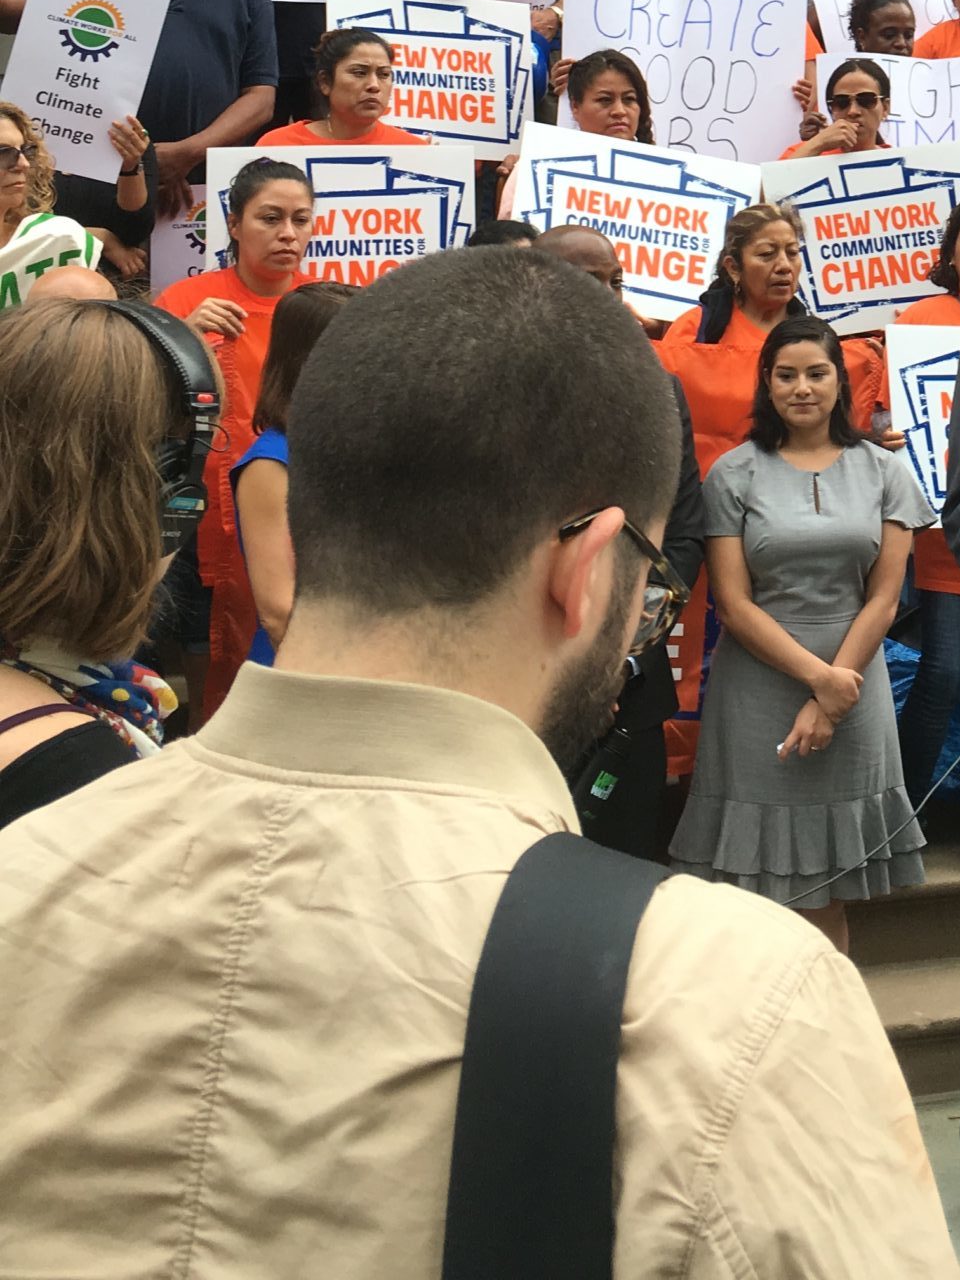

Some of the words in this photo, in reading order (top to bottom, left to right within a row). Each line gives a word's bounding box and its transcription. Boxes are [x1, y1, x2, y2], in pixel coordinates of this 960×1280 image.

[47, 14, 79, 27] CLIMATE
[80, 22, 107, 34] WORKS
[123, 34, 137, 42] ALL
[390, 43, 428, 69] EW
[431, 46, 493, 75] YORK
[55, 67, 100, 90] Fight
[391, 70, 487, 92] MMUNITIES
[619, 47, 758, 114] OOD
[35, 91, 104, 119] Climate
[341, 208, 424, 235] YORK
[566, 186, 632, 220] NEW
[637, 198, 710, 235] YORK
[814, 210, 871, 241] NEW
[874, 201, 940, 232] YORK
[304, 238, 415, 258] MMUNITIES
[417, 238, 426, 255] FOR
[701, 237, 710, 253] FOR
[820, 230, 936, 260] COMMUNITIES
[614, 241, 707, 286] ANGE
